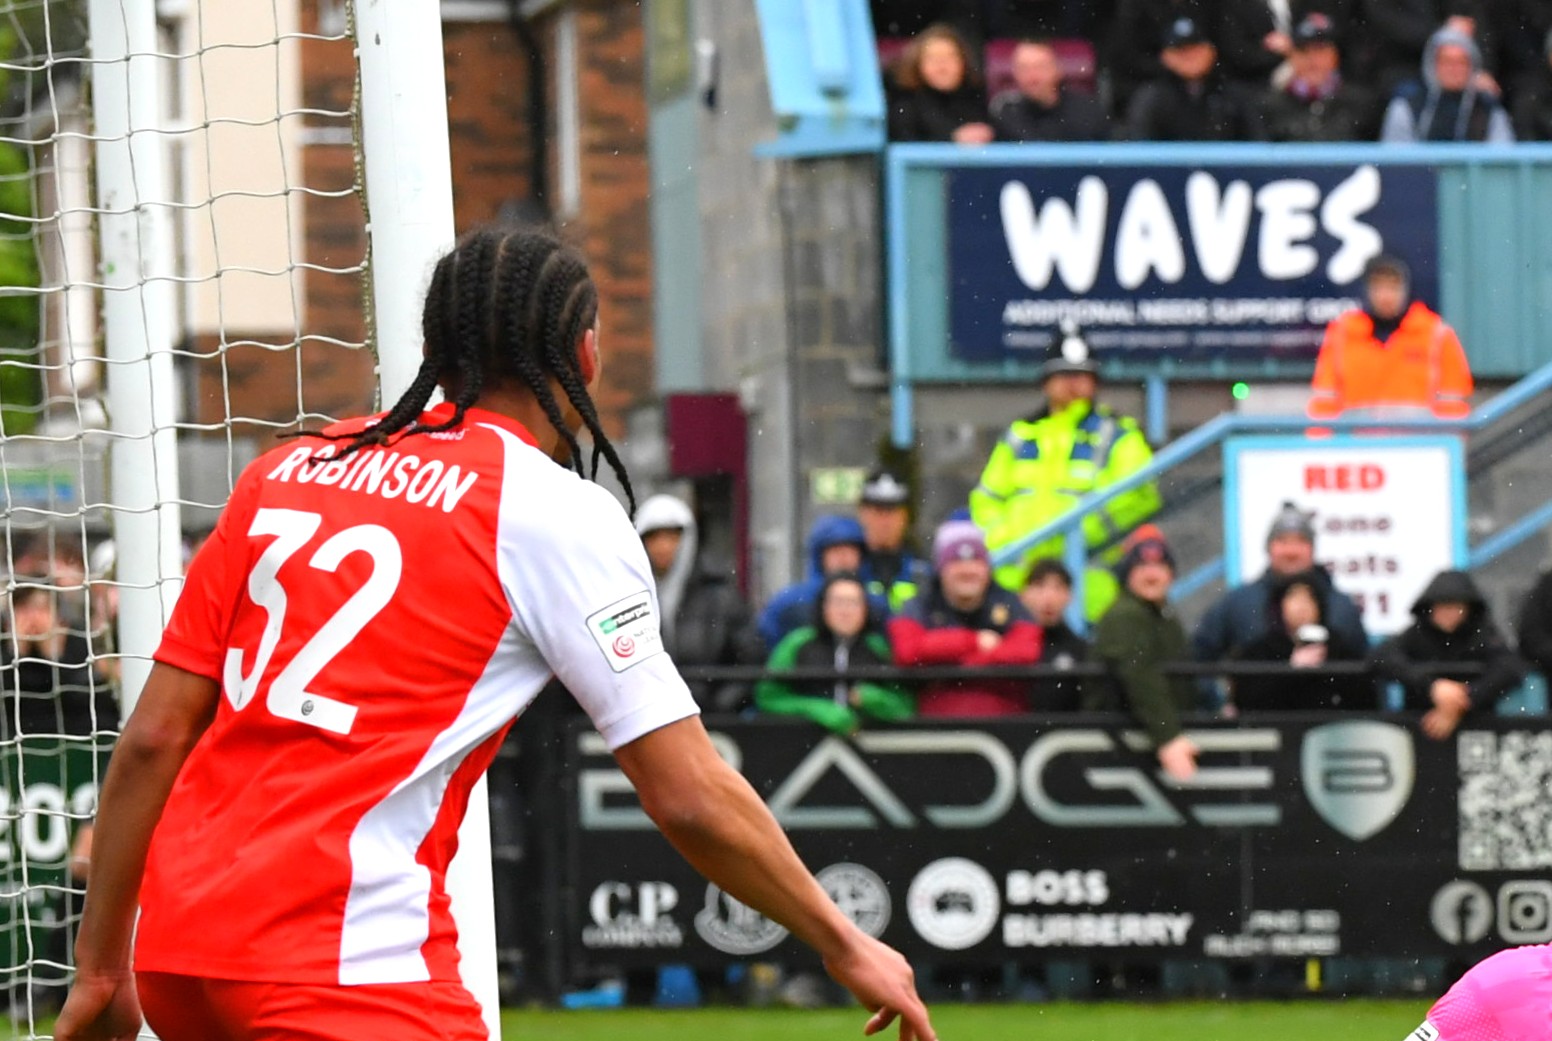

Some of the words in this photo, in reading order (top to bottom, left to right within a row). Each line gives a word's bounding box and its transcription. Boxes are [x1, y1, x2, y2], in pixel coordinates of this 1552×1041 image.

[1000, 164, 1383, 294] WAVES
[1002, 299, 1136, 325] ADDITIONAL
[1137, 299, 1207, 325] NEEDS
[1212, 299, 1303, 325] SUPPORT
[267, 444, 478, 513] ROBINSON
[1305, 465, 1384, 490] RED
[223, 508, 402, 735] 32
[1005, 869, 1109, 905] BOSS
[1003, 913, 1193, 947] BURBERRY
